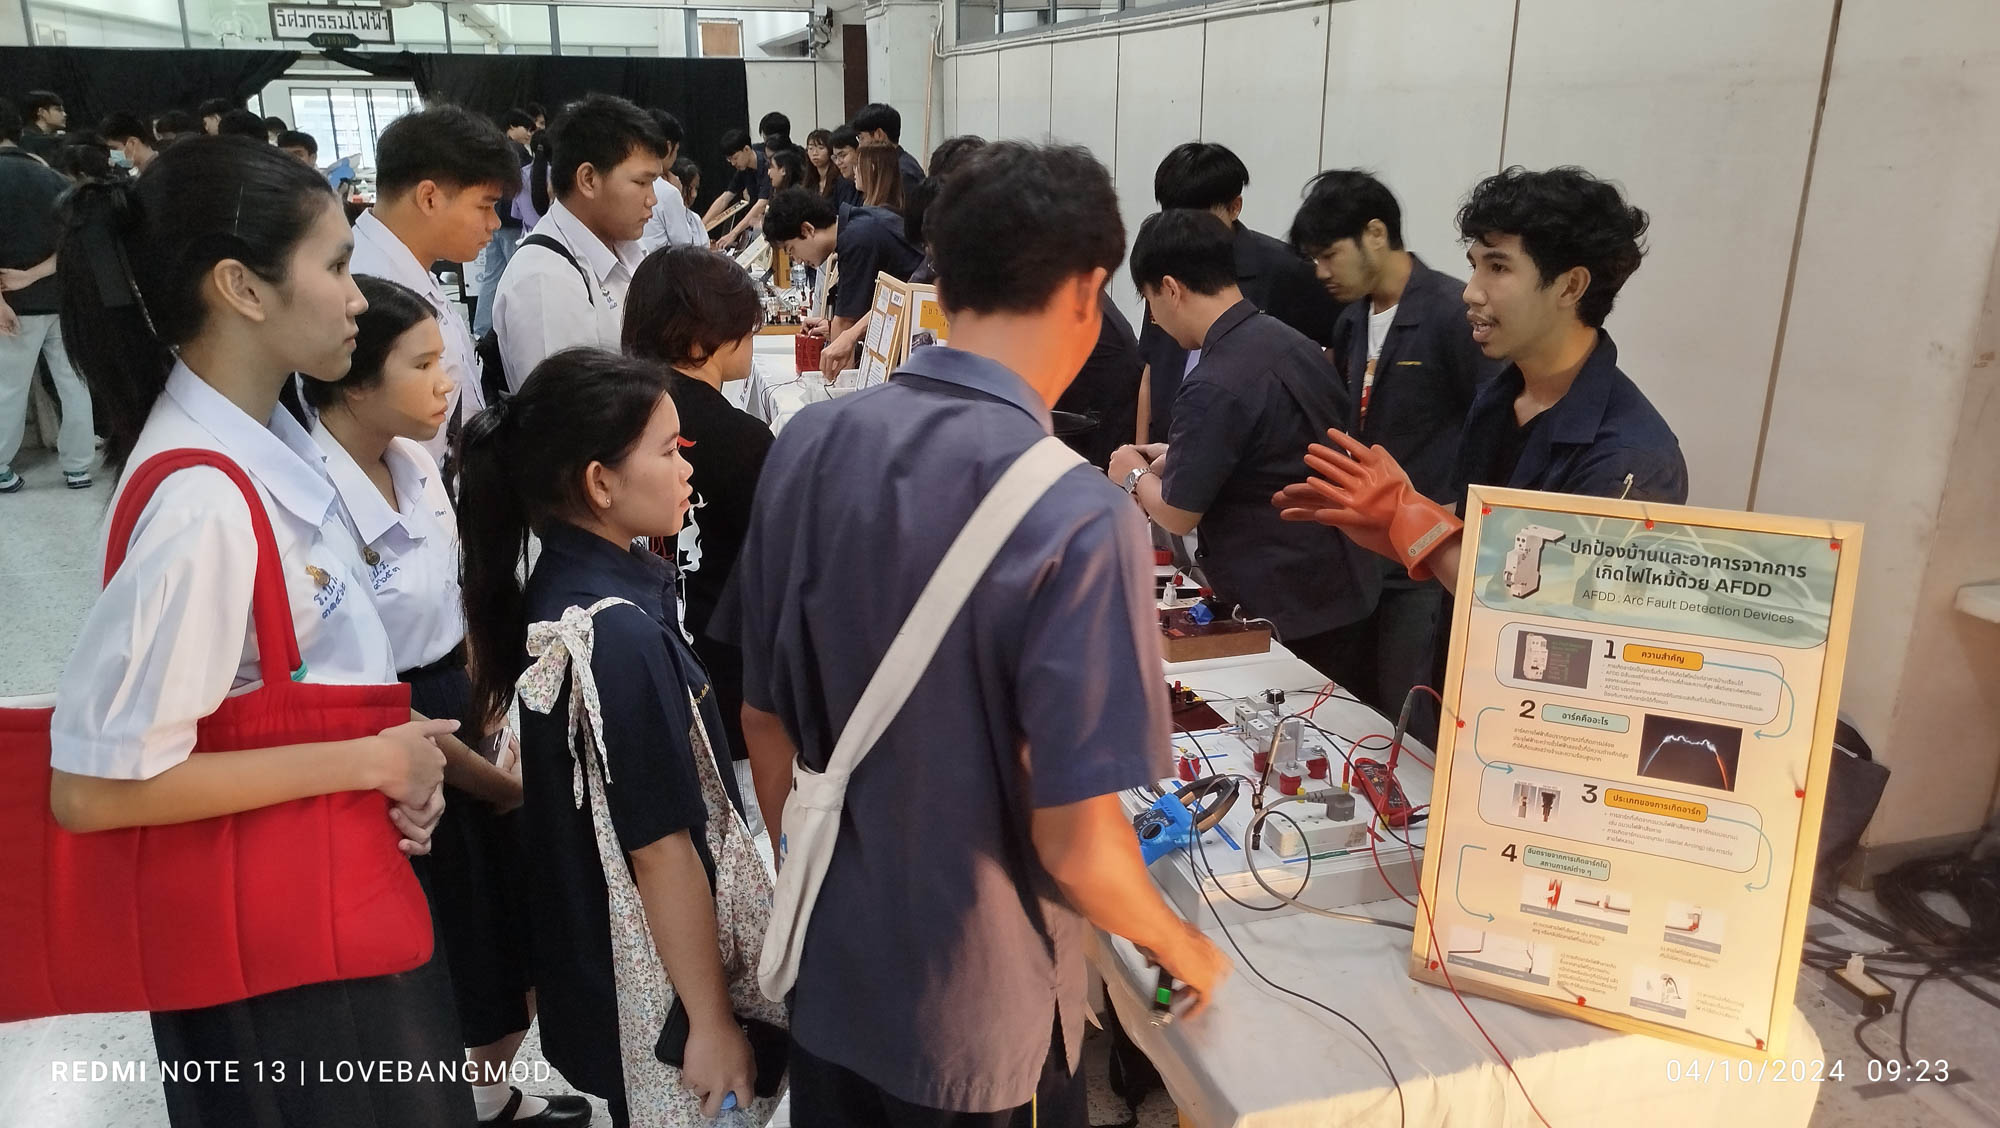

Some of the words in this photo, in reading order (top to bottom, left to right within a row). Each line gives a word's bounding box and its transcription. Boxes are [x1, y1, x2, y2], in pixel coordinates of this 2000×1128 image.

[276, 9, 389, 31] วิศวกรรมไฟฟ้า
[1570, 539, 1807, 578] ปกป้องบ้านและอาคารจากการ
[1596, 564, 1709, 591] เกิดไฟไหม้ด้วย
[1714, 578, 1772, 597] AFDD
[1582, 589, 1616, 602] AFDD
[1623, 594, 1644, 606] Arc
[1646, 597, 1676, 610] Fault
[1680, 600, 1740, 617] Detection
[1743, 607, 1794, 624] Devices
[1604, 640, 1616, 659] 1
[1641, 651, 1685, 664] ความสำคัญ
[1519, 700, 1536, 719] 2
[1581, 784, 1598, 804] 3
[1613, 794, 1701, 816] ประเภทของการเกิดอาร์ก
[1501, 843, 1518, 862] 4
